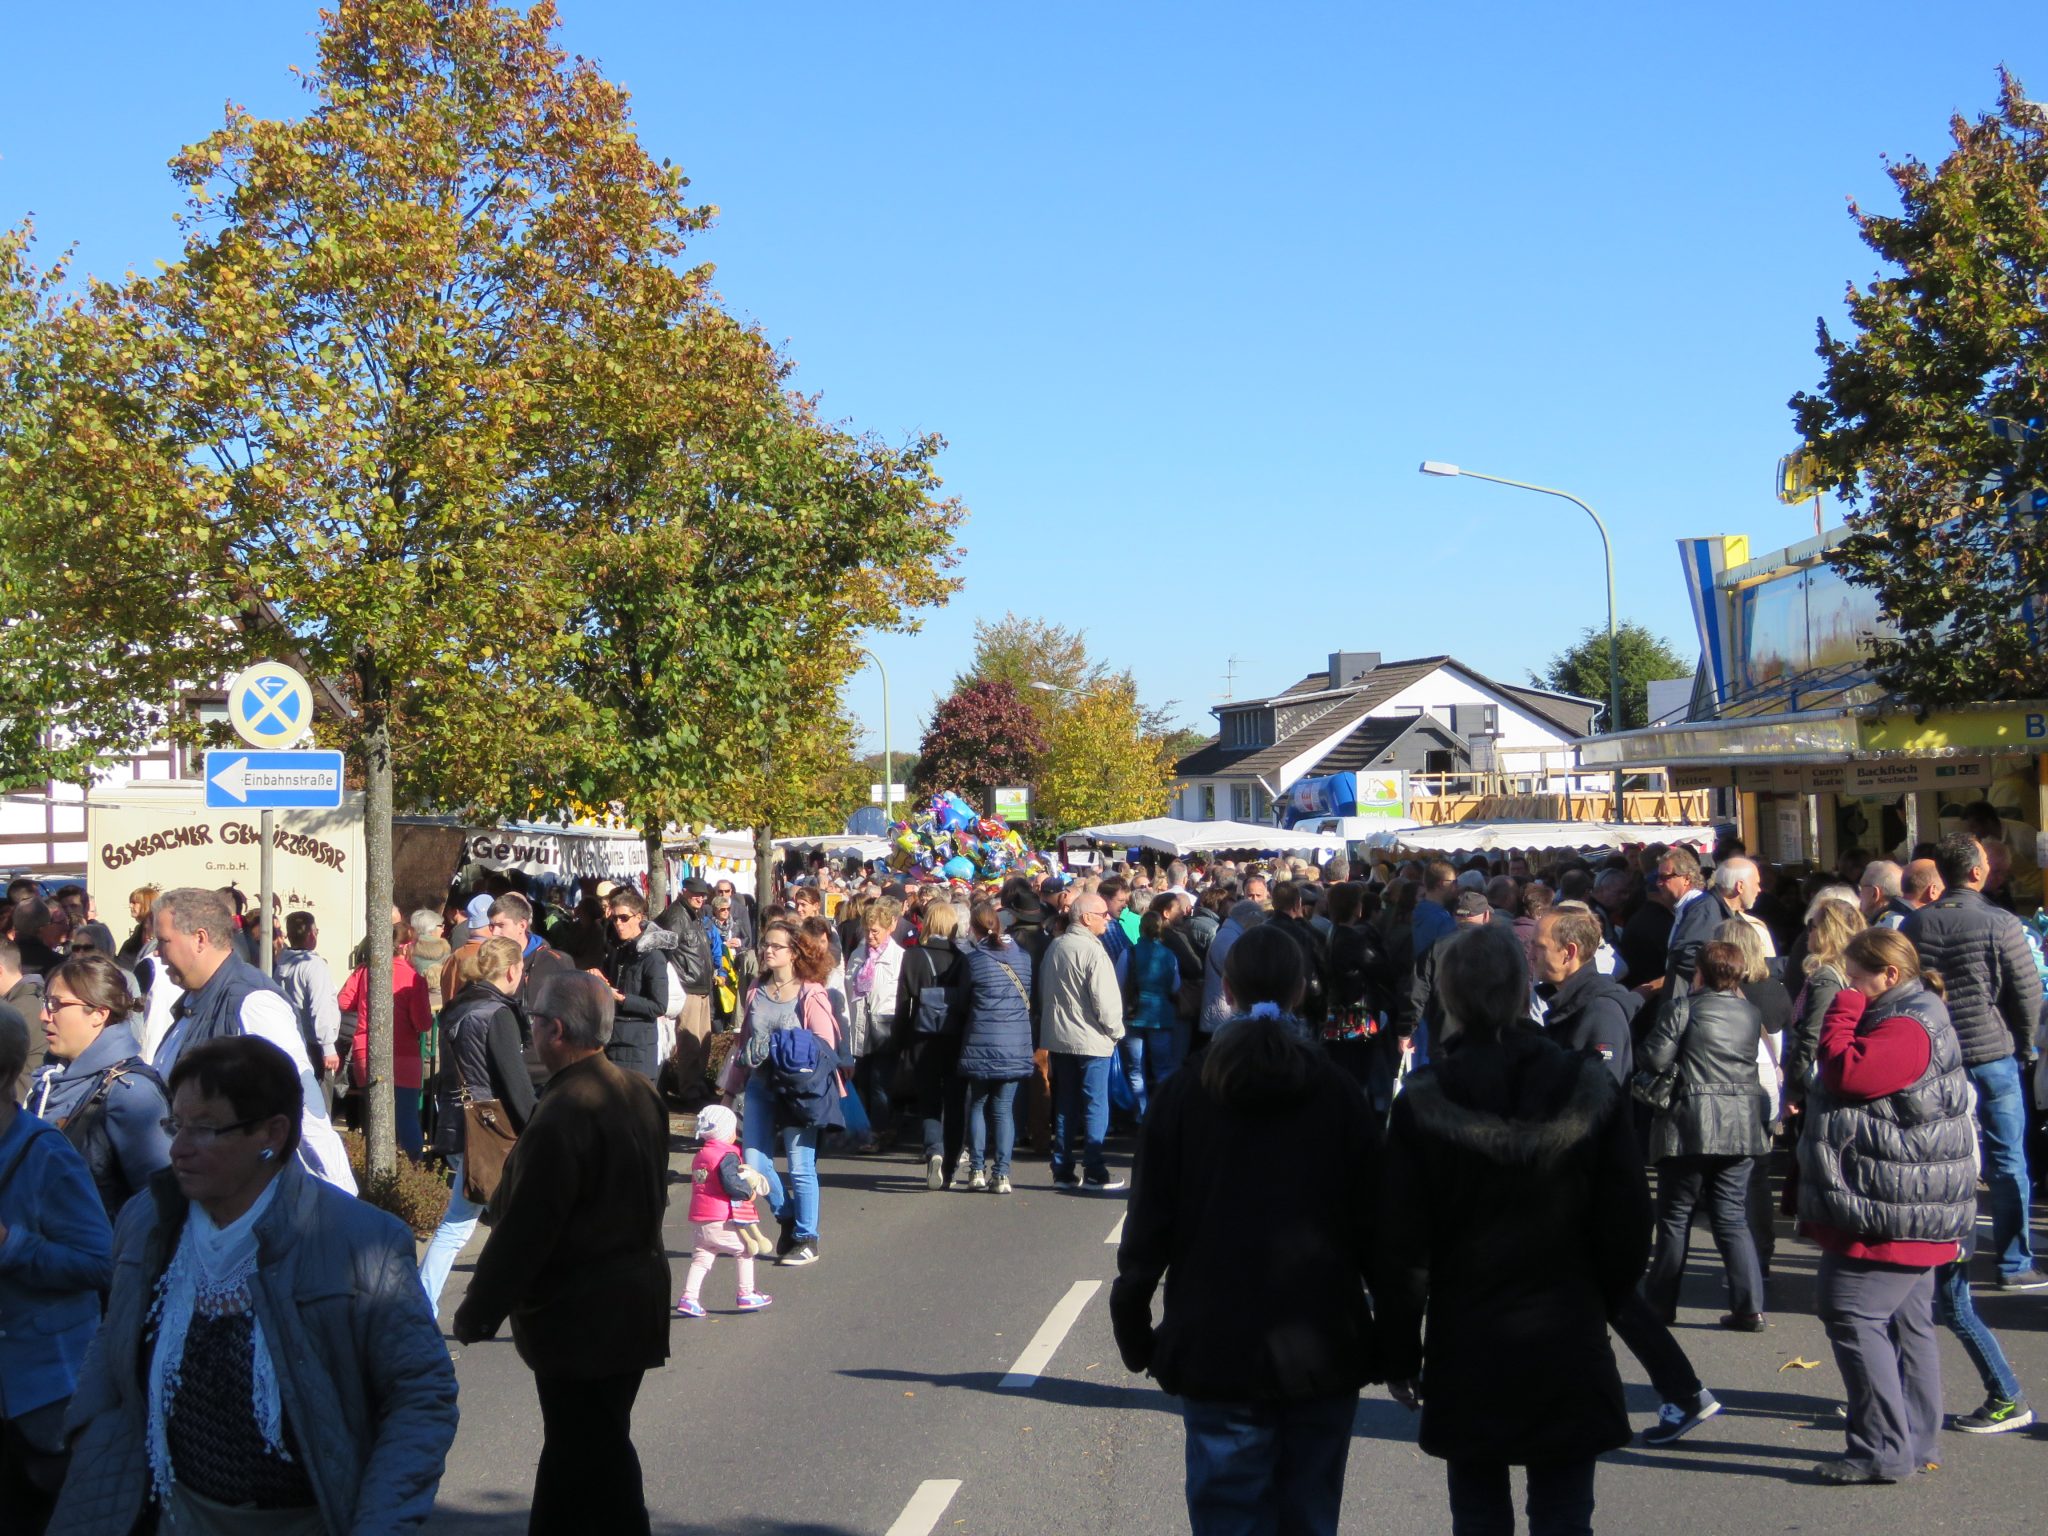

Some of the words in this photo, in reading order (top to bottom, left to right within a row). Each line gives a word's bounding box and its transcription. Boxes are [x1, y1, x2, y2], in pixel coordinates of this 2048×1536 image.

[1857, 763, 1918, 778] Backfisch
[243, 773, 334, 786] Einbahnstraße
[1675, 775, 1712, 787] Fritten
[205, 861, 249, 871] G.m.b.H.
